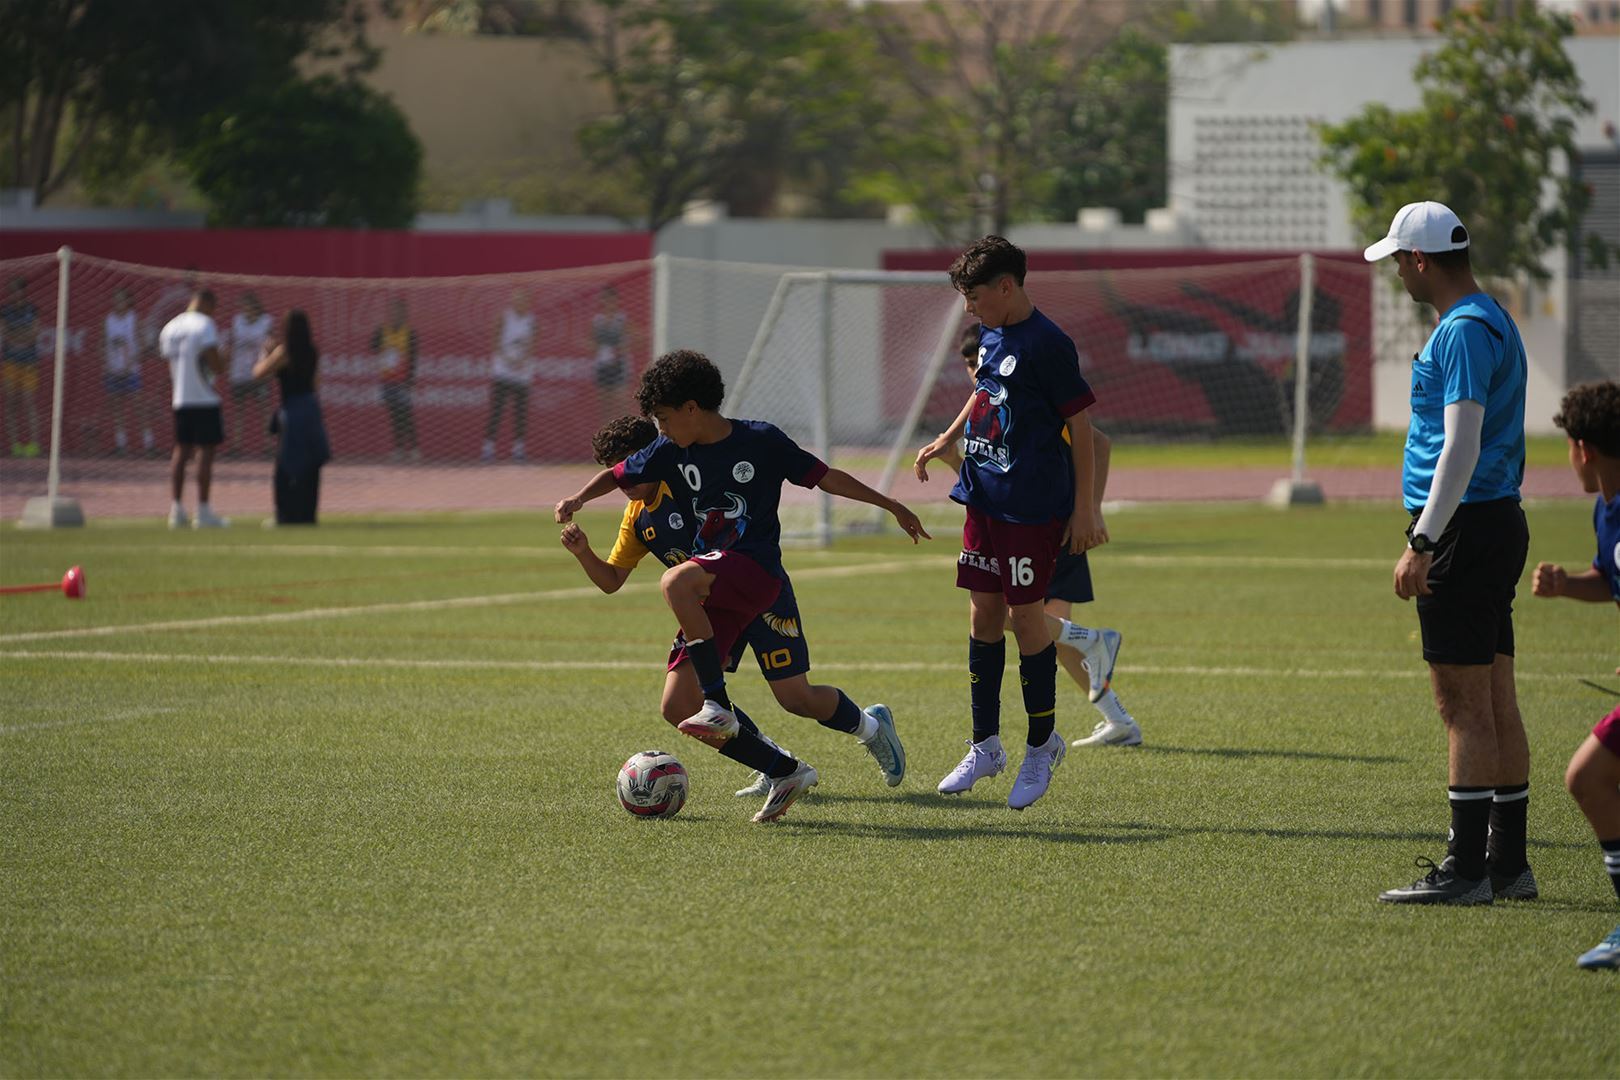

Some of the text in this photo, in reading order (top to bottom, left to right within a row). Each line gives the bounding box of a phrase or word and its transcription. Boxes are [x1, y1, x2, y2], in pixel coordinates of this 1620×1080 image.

[642, 526, 657, 541] 10
[959, 551, 1001, 575] ULLS
[1009, 556, 1034, 586] 16
[761, 648, 792, 670] 10
